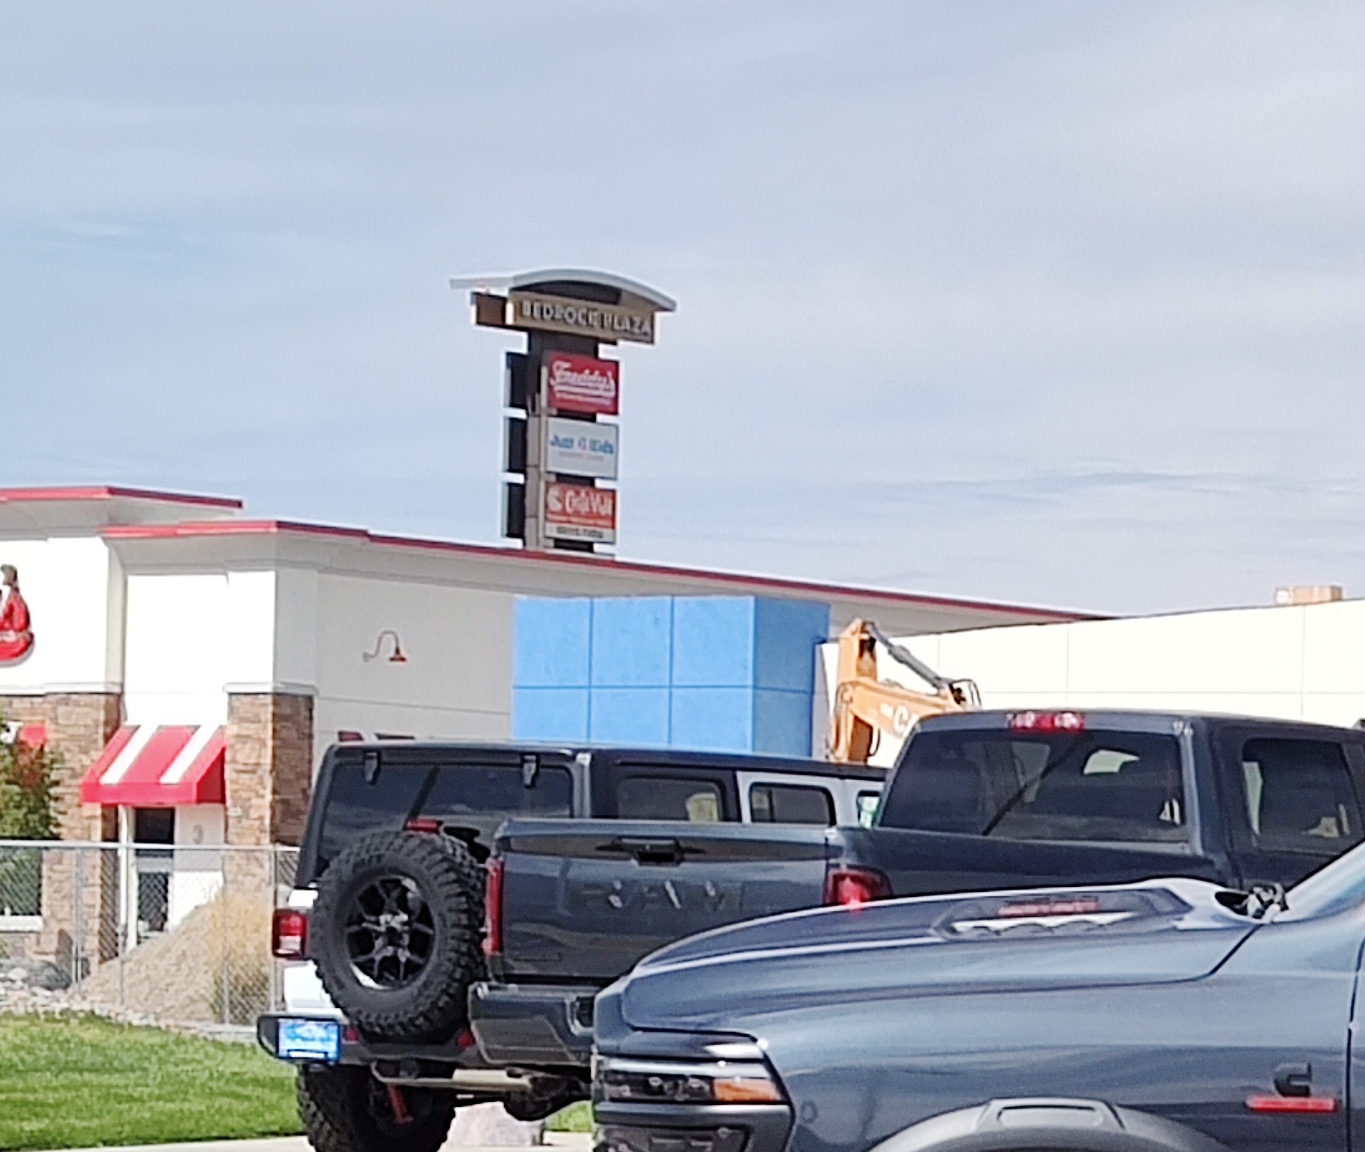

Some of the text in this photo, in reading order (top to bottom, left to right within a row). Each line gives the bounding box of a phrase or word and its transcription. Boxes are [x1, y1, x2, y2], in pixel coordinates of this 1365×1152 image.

[521, 300, 652, 335] BEDROCK PLAZA
[583, 879, 746, 913] RAM
